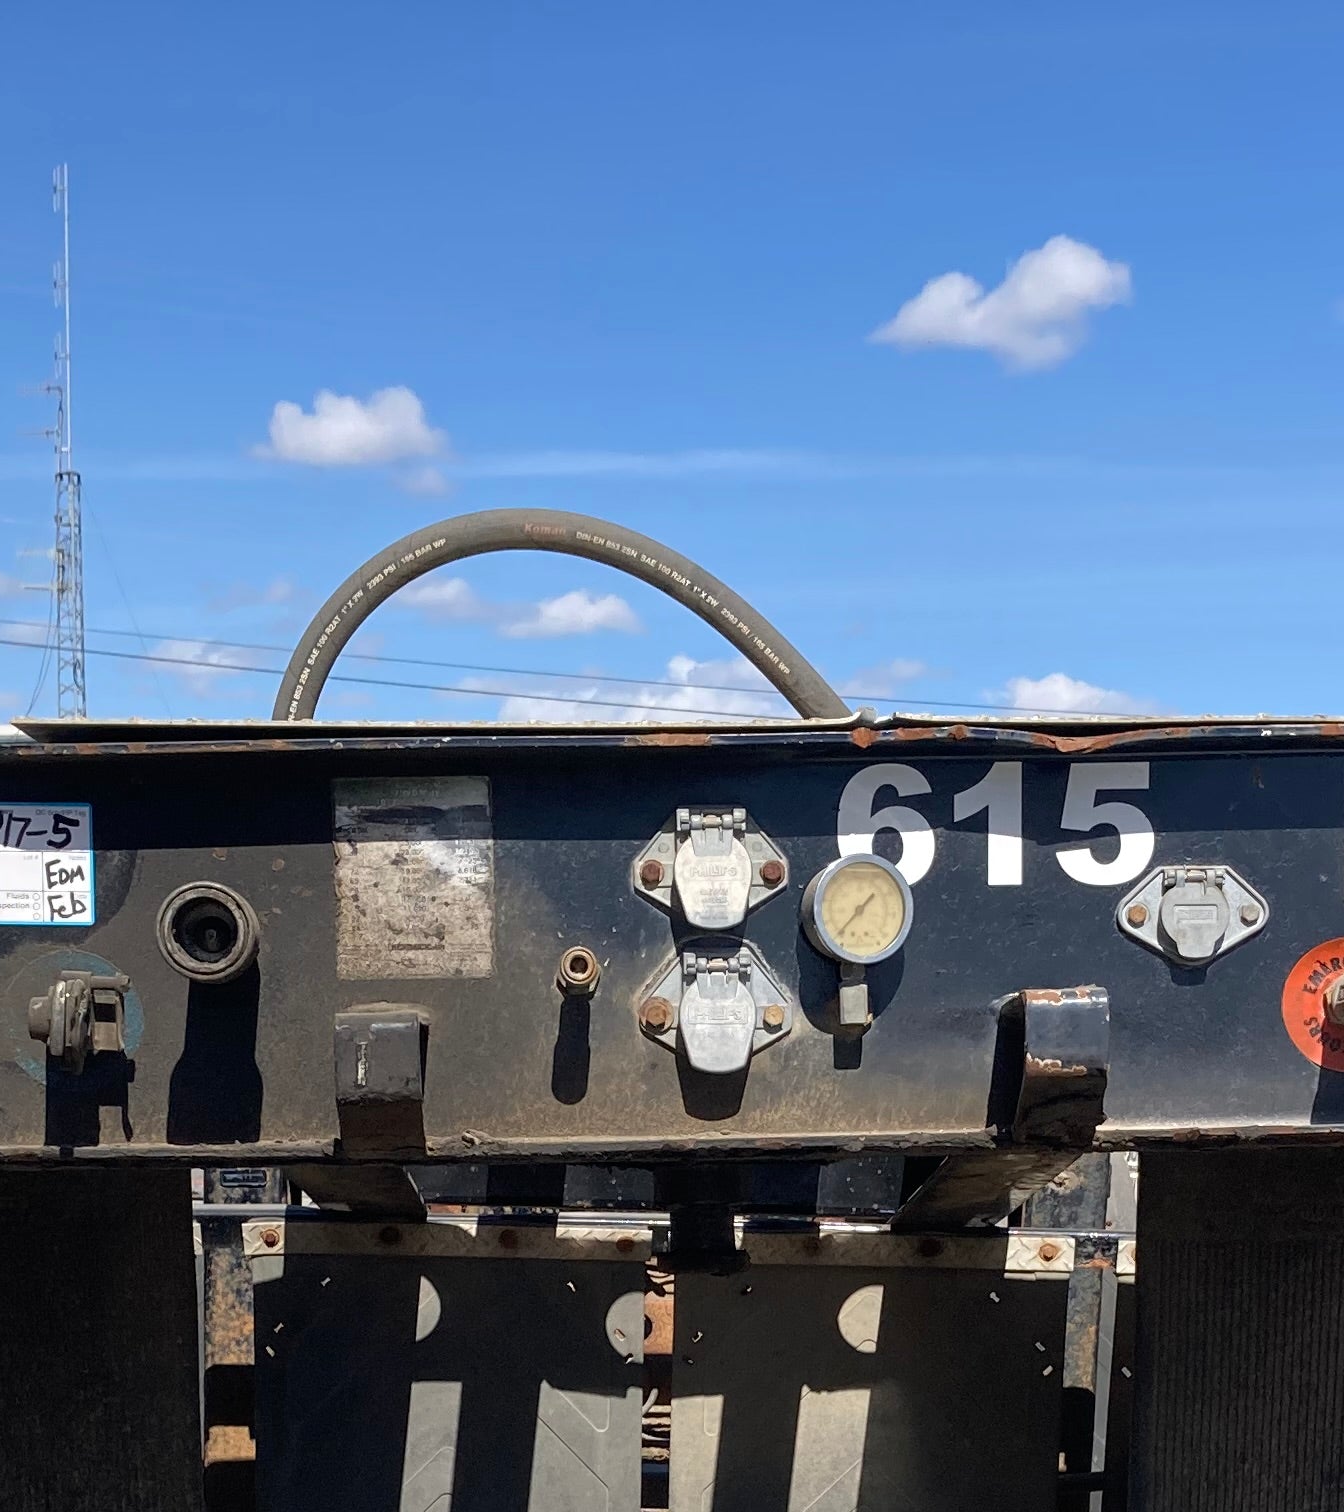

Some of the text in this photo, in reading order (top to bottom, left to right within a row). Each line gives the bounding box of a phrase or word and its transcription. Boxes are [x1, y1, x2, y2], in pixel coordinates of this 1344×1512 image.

[308, 649, 320, 665] SAE
[316, 635, 328, 648] 100
[325, 615, 342, 637] R2AT
[383, 563, 396, 576] PSI
[414, 544, 433, 558] BAR
[433, 537, 446, 549] WP
[640, 553, 657, 567] SAE
[658, 563, 671, 575] 100
[671, 571, 691, 587] R2AT
[737, 621, 751, 635] PSI
[764, 647, 779, 664] BAR
[837, 761, 1155, 886] 615
[47, 891, 87, 922] Feb
